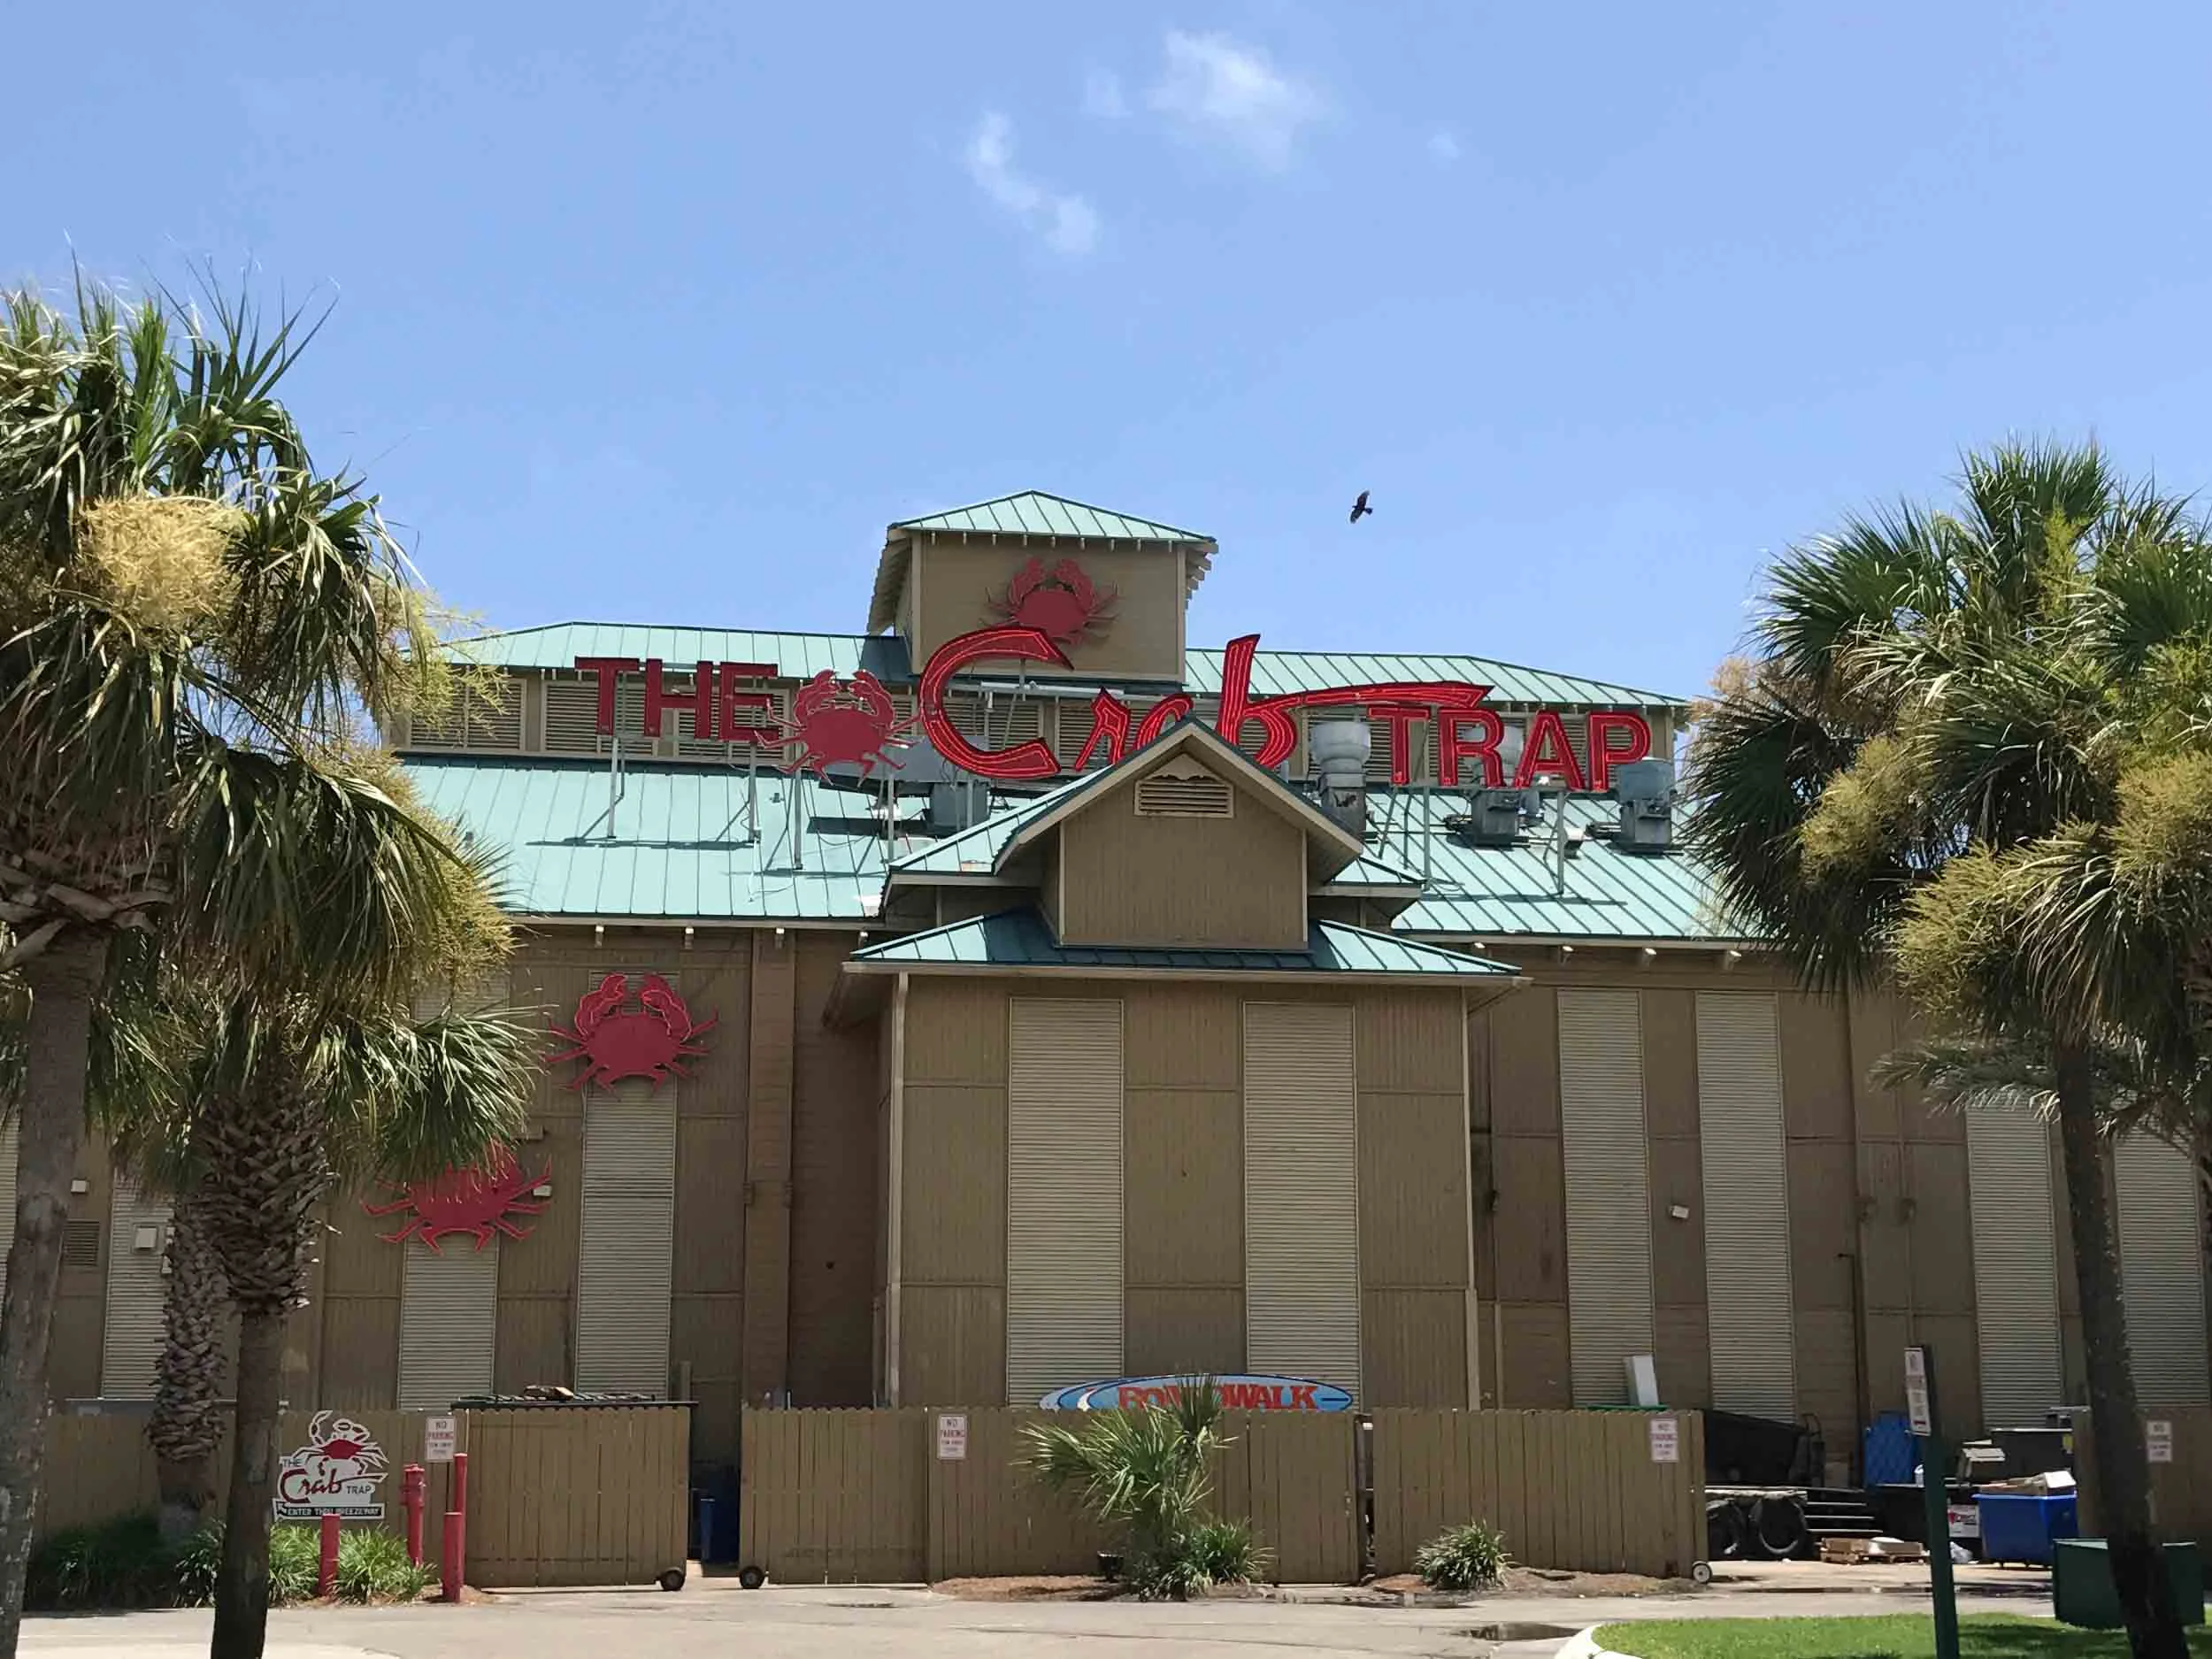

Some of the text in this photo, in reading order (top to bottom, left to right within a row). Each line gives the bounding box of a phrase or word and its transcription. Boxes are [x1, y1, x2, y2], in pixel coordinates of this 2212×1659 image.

[574, 625, 1651, 792] THE Crab TRAP
[1118, 1384, 1318, 1409] BOAWALK
[282, 1459, 303, 1468] THE
[280, 1468, 384, 1504] Crab TRAP
